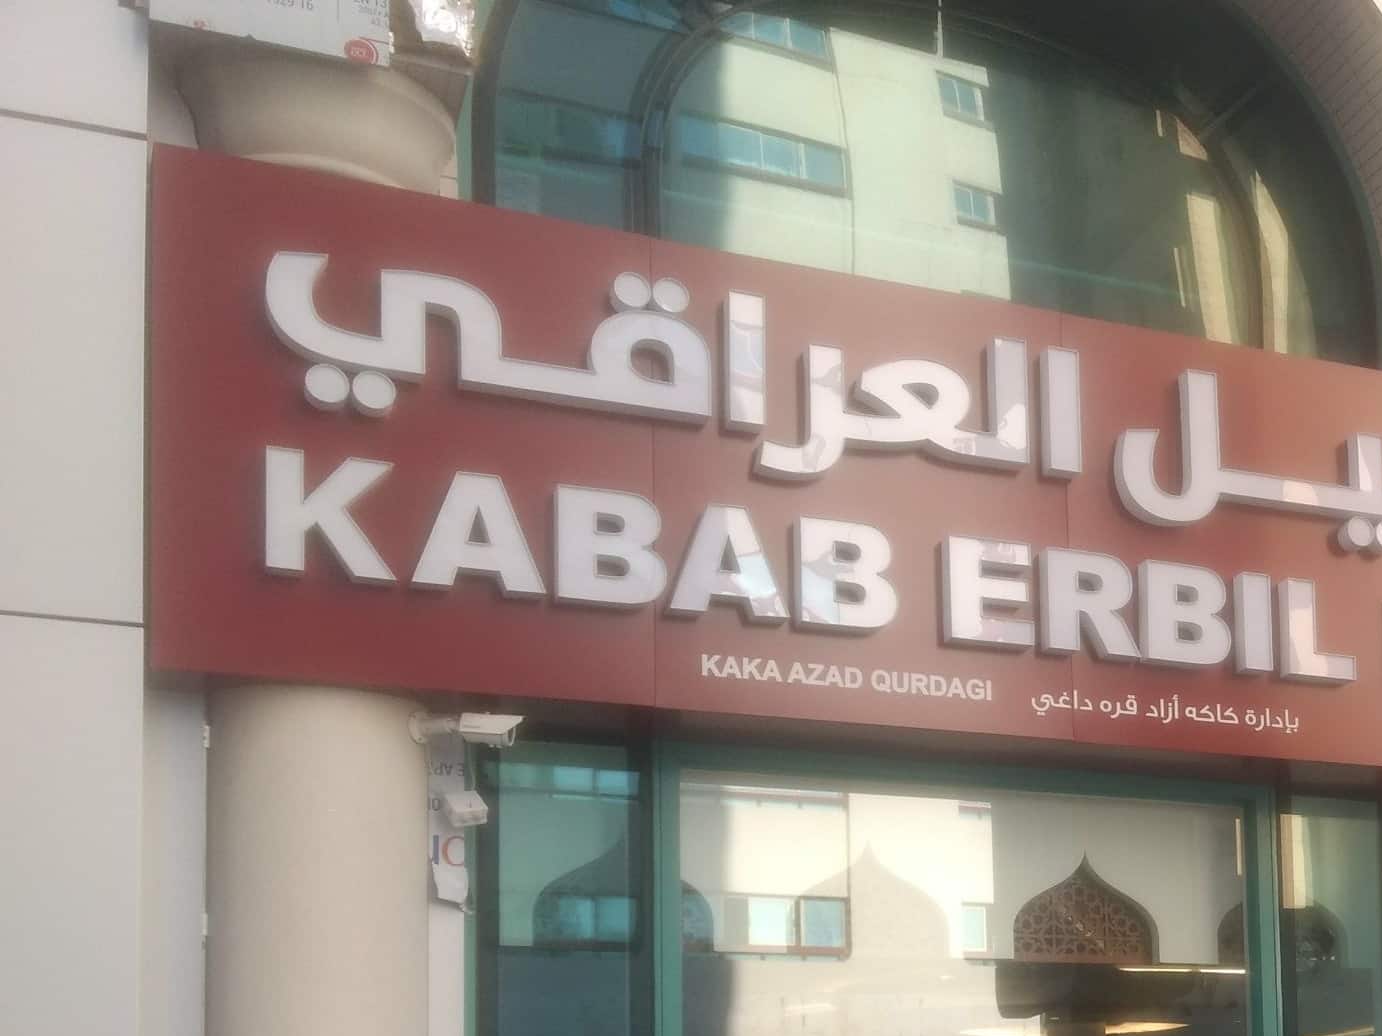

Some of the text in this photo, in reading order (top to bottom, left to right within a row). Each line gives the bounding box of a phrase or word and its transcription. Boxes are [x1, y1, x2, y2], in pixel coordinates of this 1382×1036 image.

[265, 250, 1083, 481] العراقي
[264, 445, 898, 631] KABAB
[940, 535, 1357, 684] ERBIL
[701, 653, 993, 701] KAKA AZAD QURDAGI
[1030, 689, 1300, 734] بإدارة كاكه أزاد قره داغي
